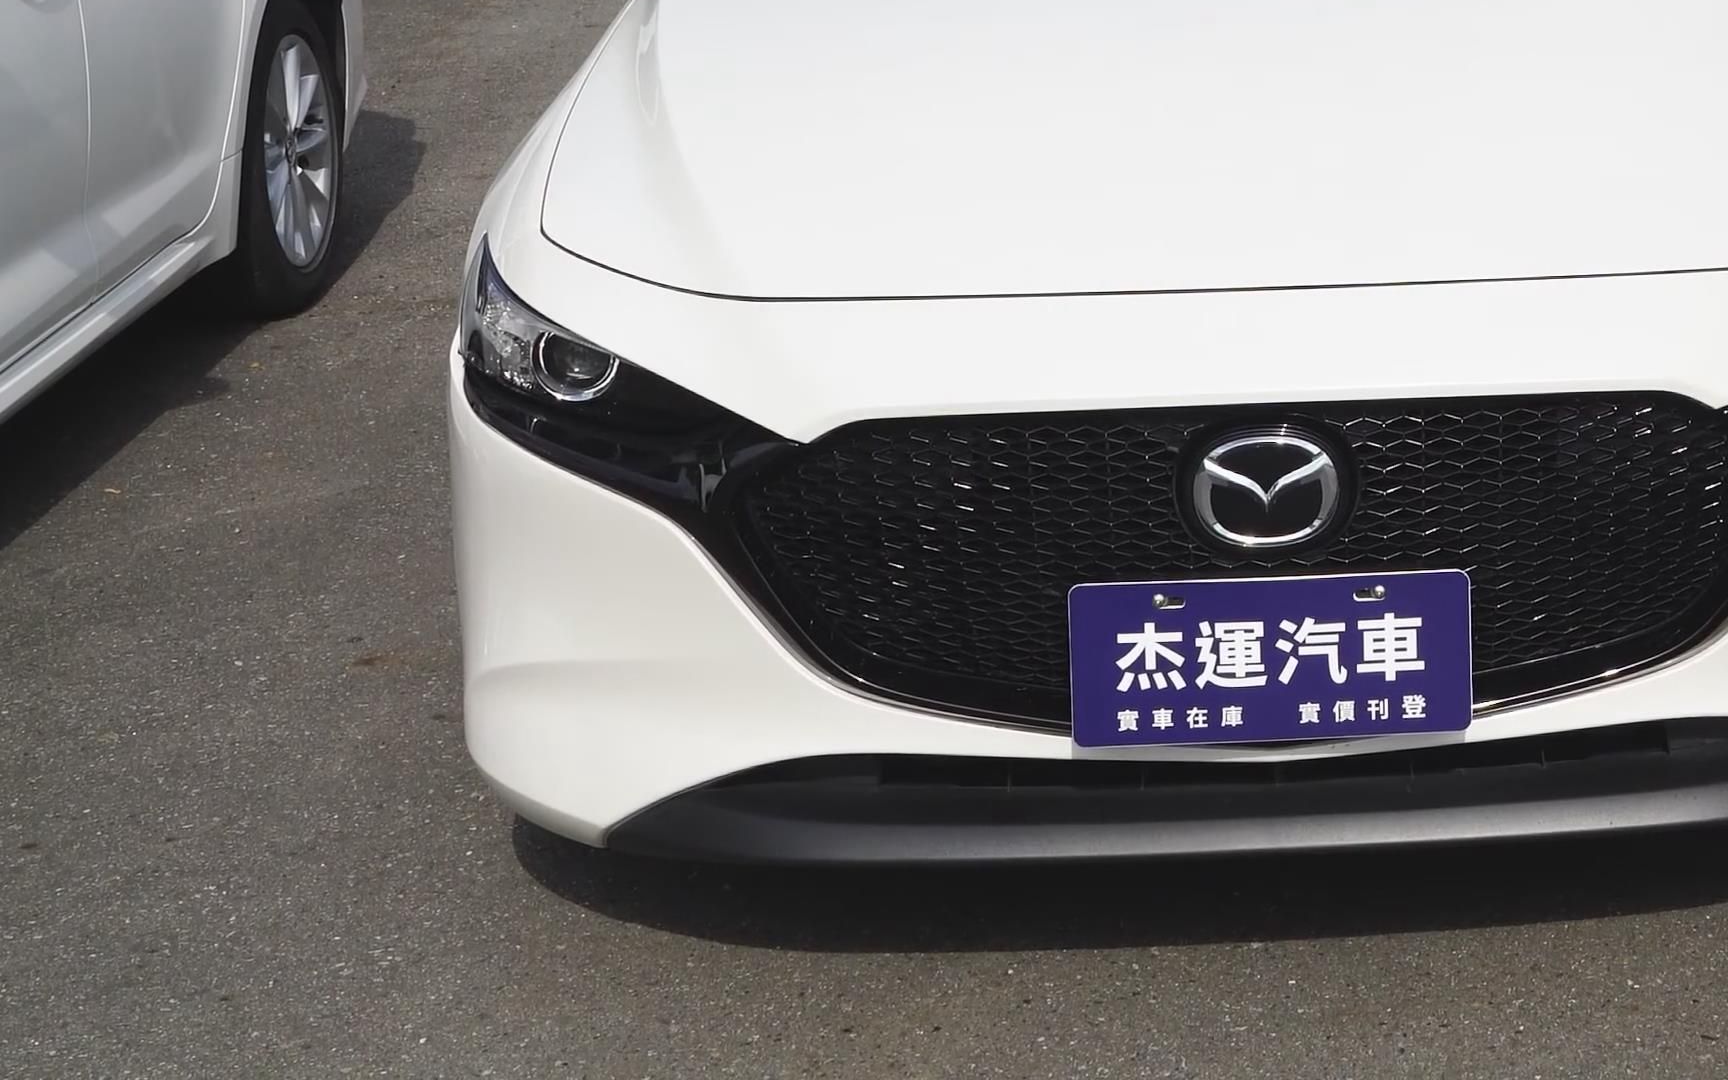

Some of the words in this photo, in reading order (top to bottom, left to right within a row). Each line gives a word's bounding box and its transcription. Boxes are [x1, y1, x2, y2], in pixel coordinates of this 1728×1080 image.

[1115, 612, 1426, 692] 杰運汽車
[1117, 706, 1244, 731] 實車在庫
[1299, 694, 1427, 724] 實價刊登
